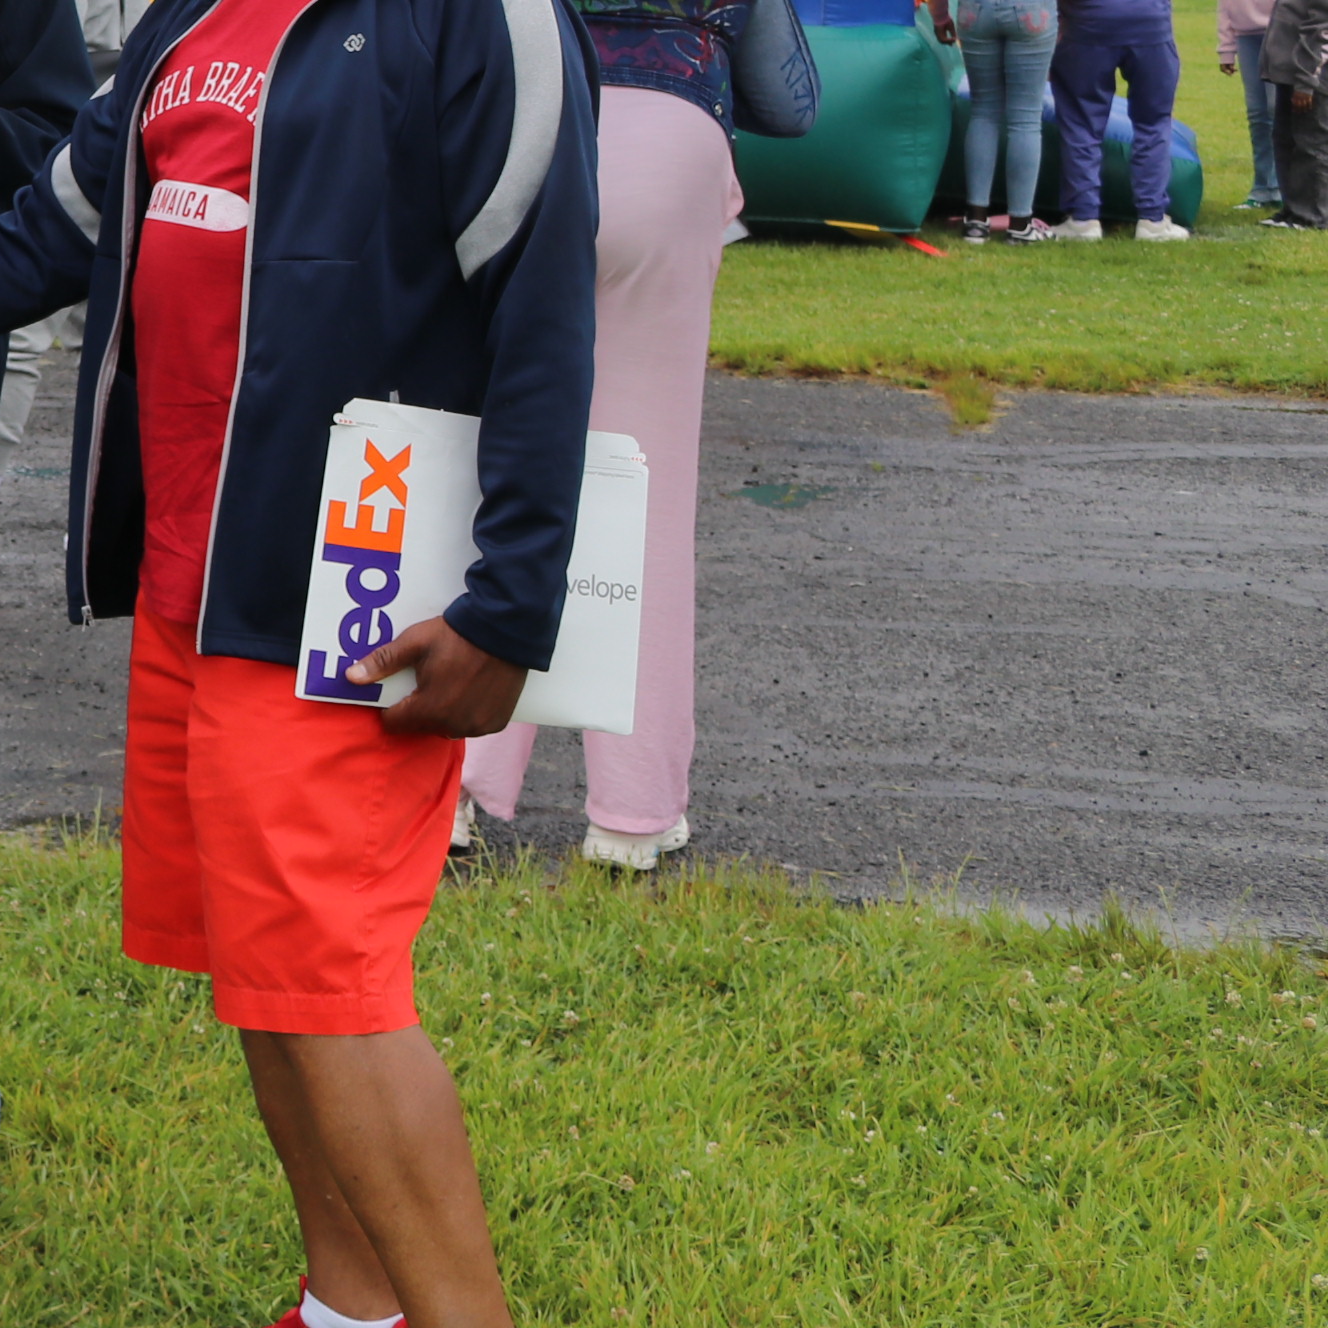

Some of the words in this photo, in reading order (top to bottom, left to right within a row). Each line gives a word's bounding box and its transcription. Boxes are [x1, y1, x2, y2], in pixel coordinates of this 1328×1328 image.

[148, 187, 209, 221] AMAICA
[304, 438, 412, 702] FedEx
[567, 573, 638, 606] velope
